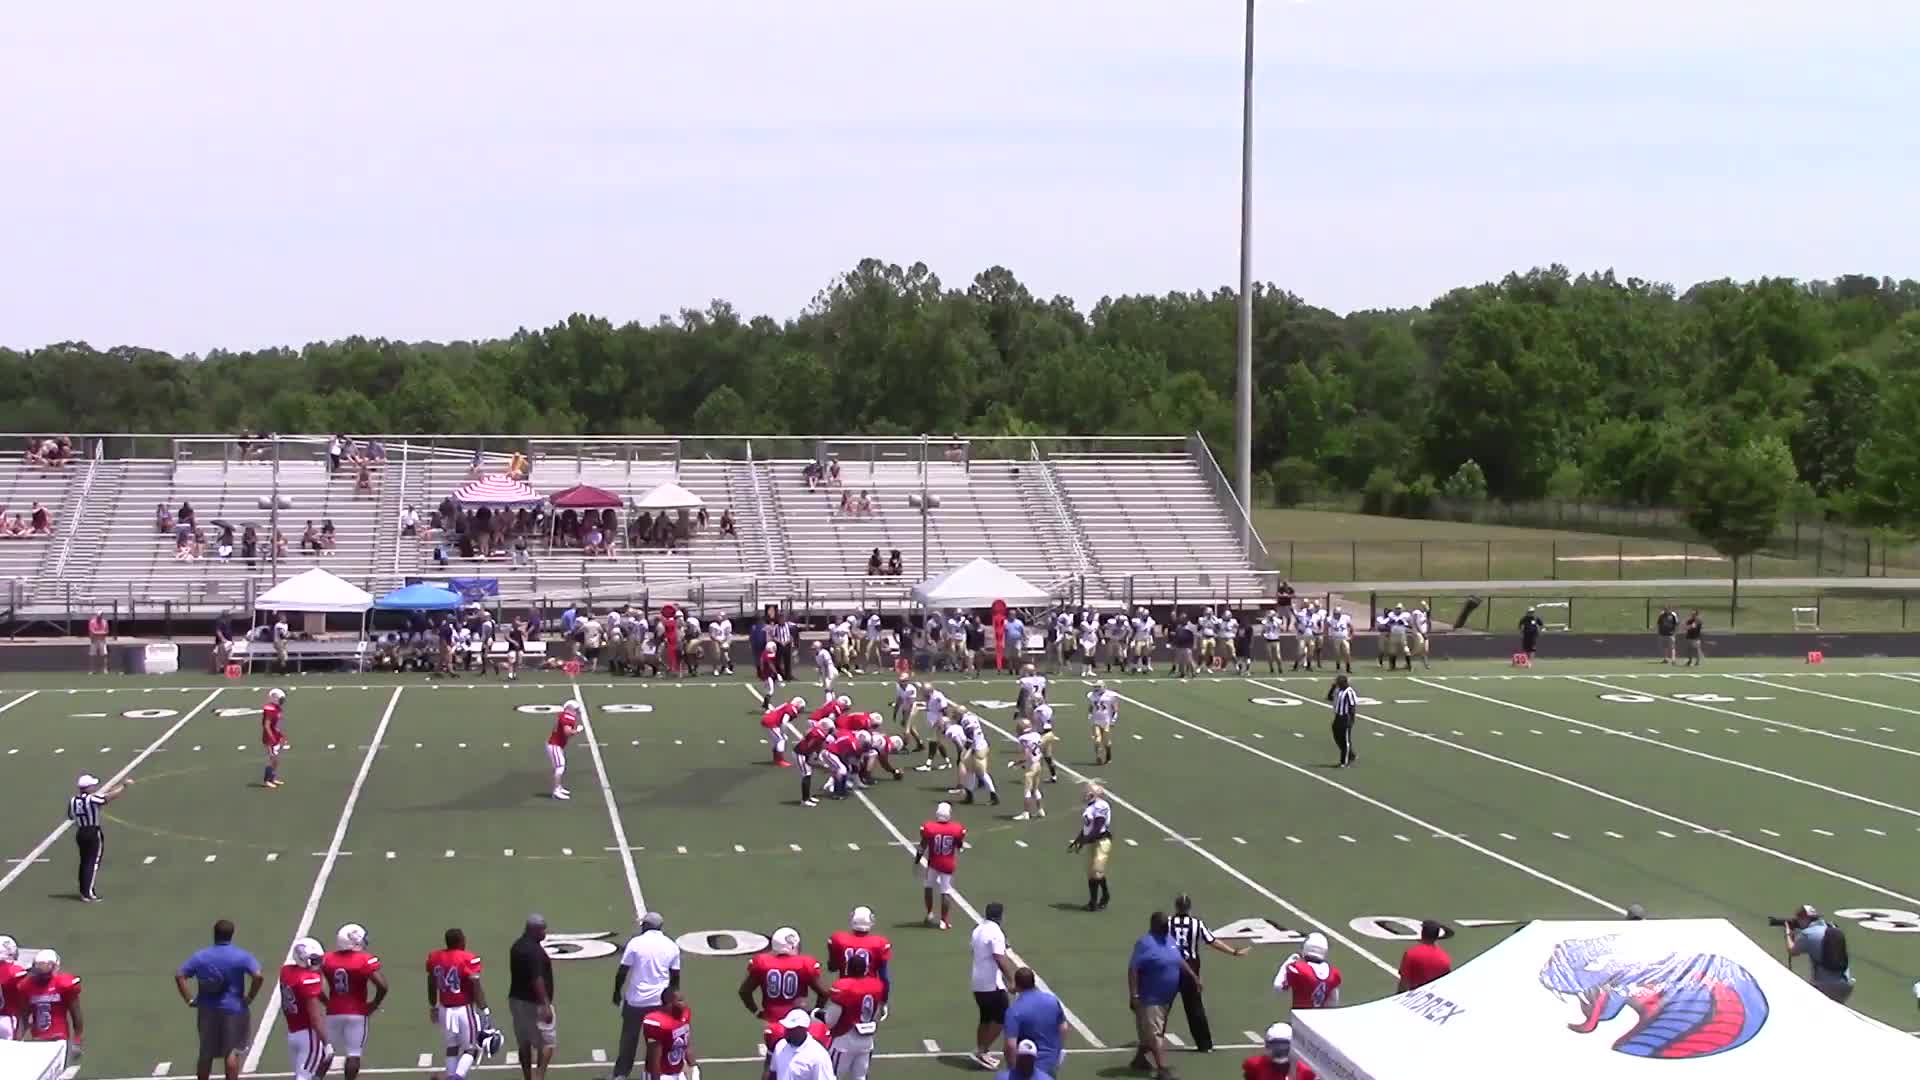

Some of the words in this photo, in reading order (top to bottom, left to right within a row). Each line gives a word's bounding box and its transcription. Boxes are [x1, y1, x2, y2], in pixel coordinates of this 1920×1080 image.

[75, 799, 87, 814] R
[1174, 926, 1190, 946] H
[766, 968, 798, 999] 90
